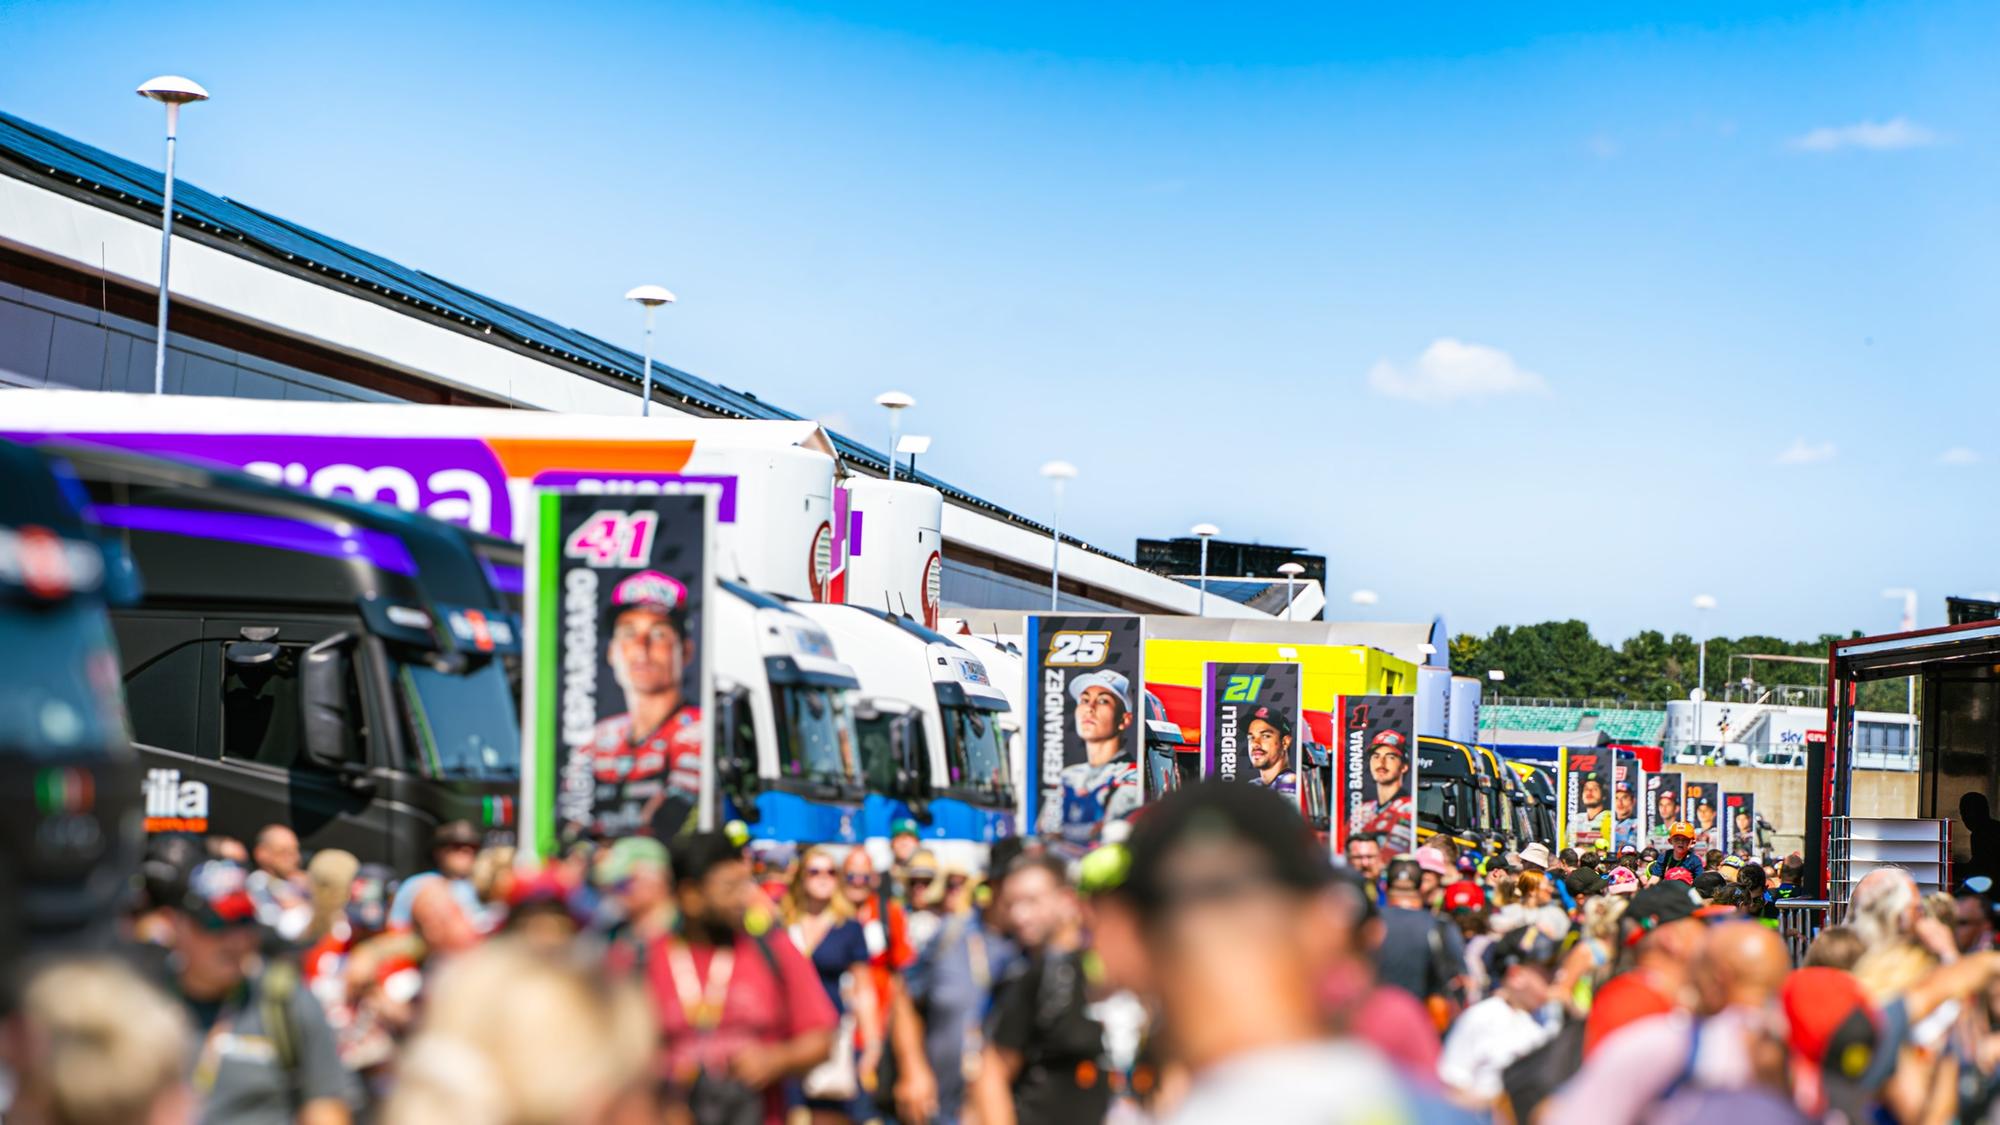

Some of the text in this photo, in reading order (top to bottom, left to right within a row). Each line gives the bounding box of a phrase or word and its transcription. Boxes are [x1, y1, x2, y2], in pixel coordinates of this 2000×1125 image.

[564, 509, 660, 568] 41
[1044, 630, 1112, 667] 25
[1220, 673, 1265, 703] 21
[1043, 668, 1065, 785] FERNANDEZ
[1221, 705, 1237, 782] ORBIDELLI
[1780, 728, 1803, 743] sky
[1349, 729, 1365, 790] BAGNAIA
[1569, 754, 1598, 772] 72
